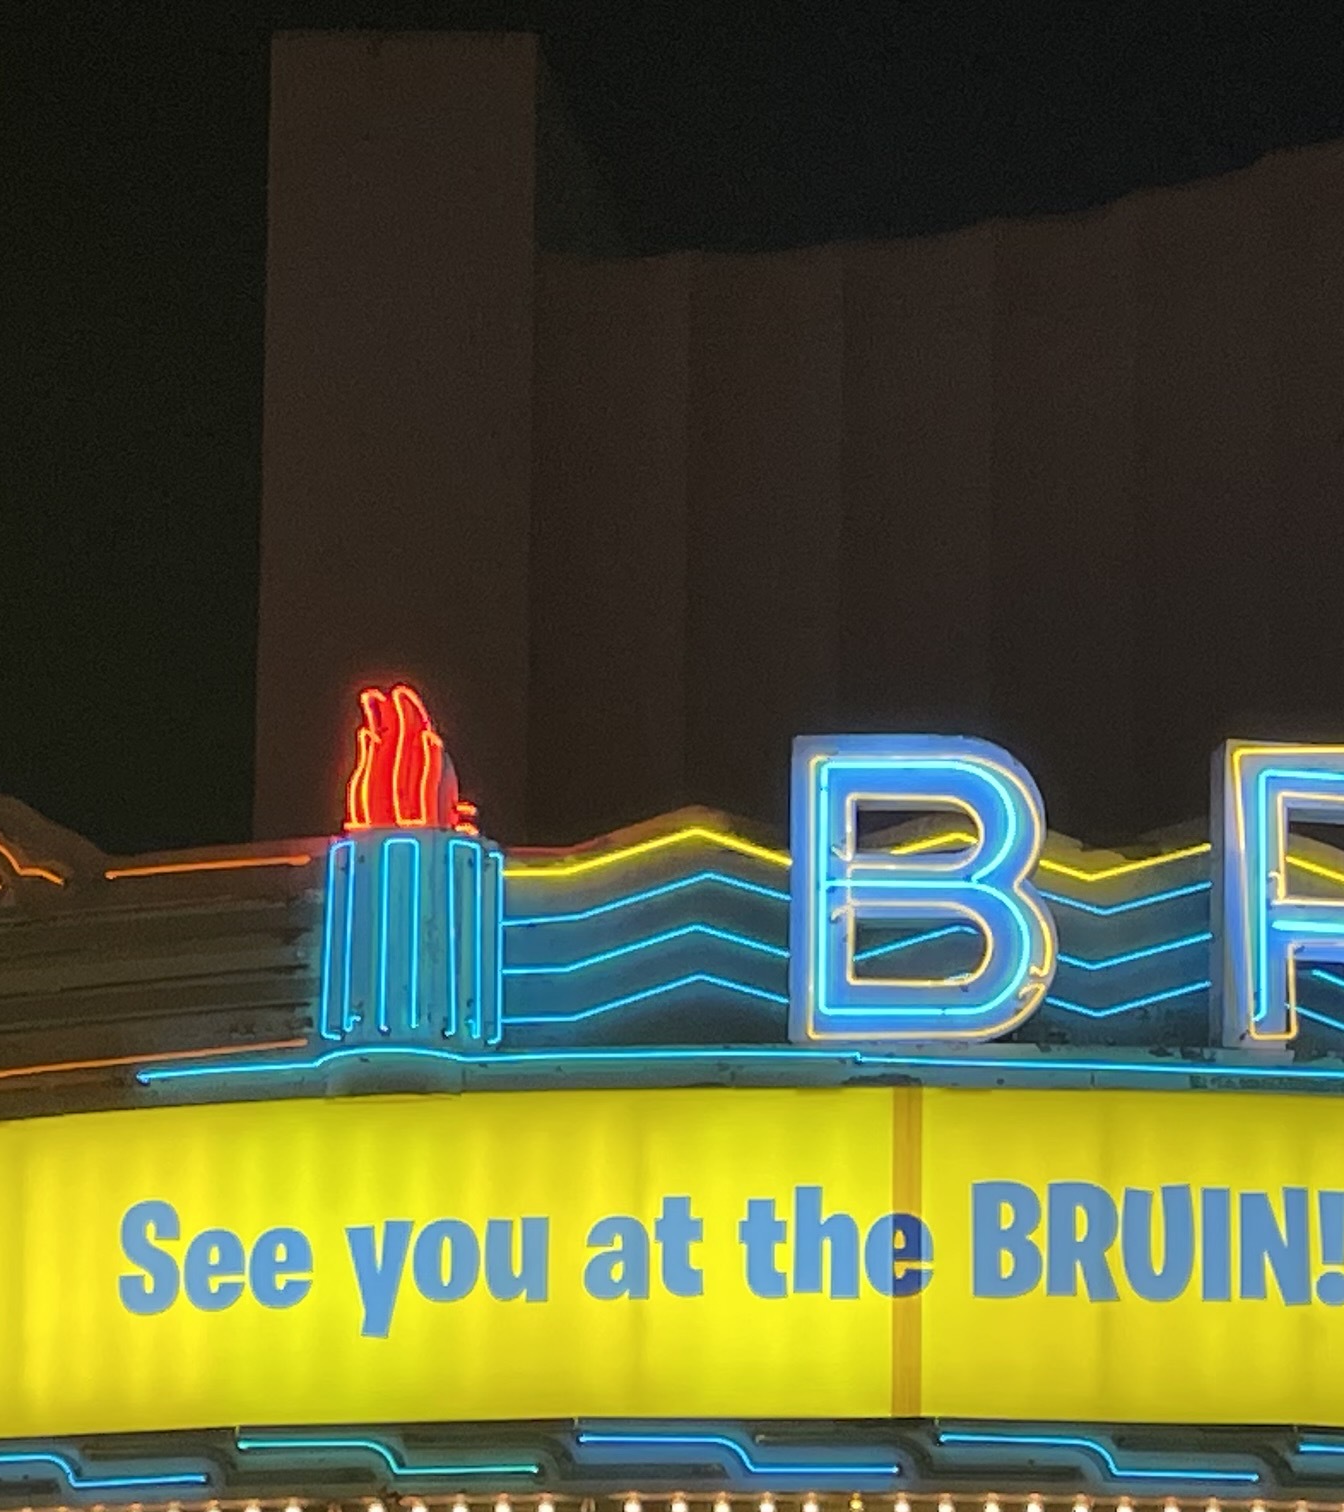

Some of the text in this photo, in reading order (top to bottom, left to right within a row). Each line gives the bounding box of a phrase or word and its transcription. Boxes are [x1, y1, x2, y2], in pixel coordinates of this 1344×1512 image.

[119, 1201, 313, 1315] See
[346, 1215, 549, 1339] you
[584, 1195, 705, 1299] at
[739, 1185, 934, 1297] the
